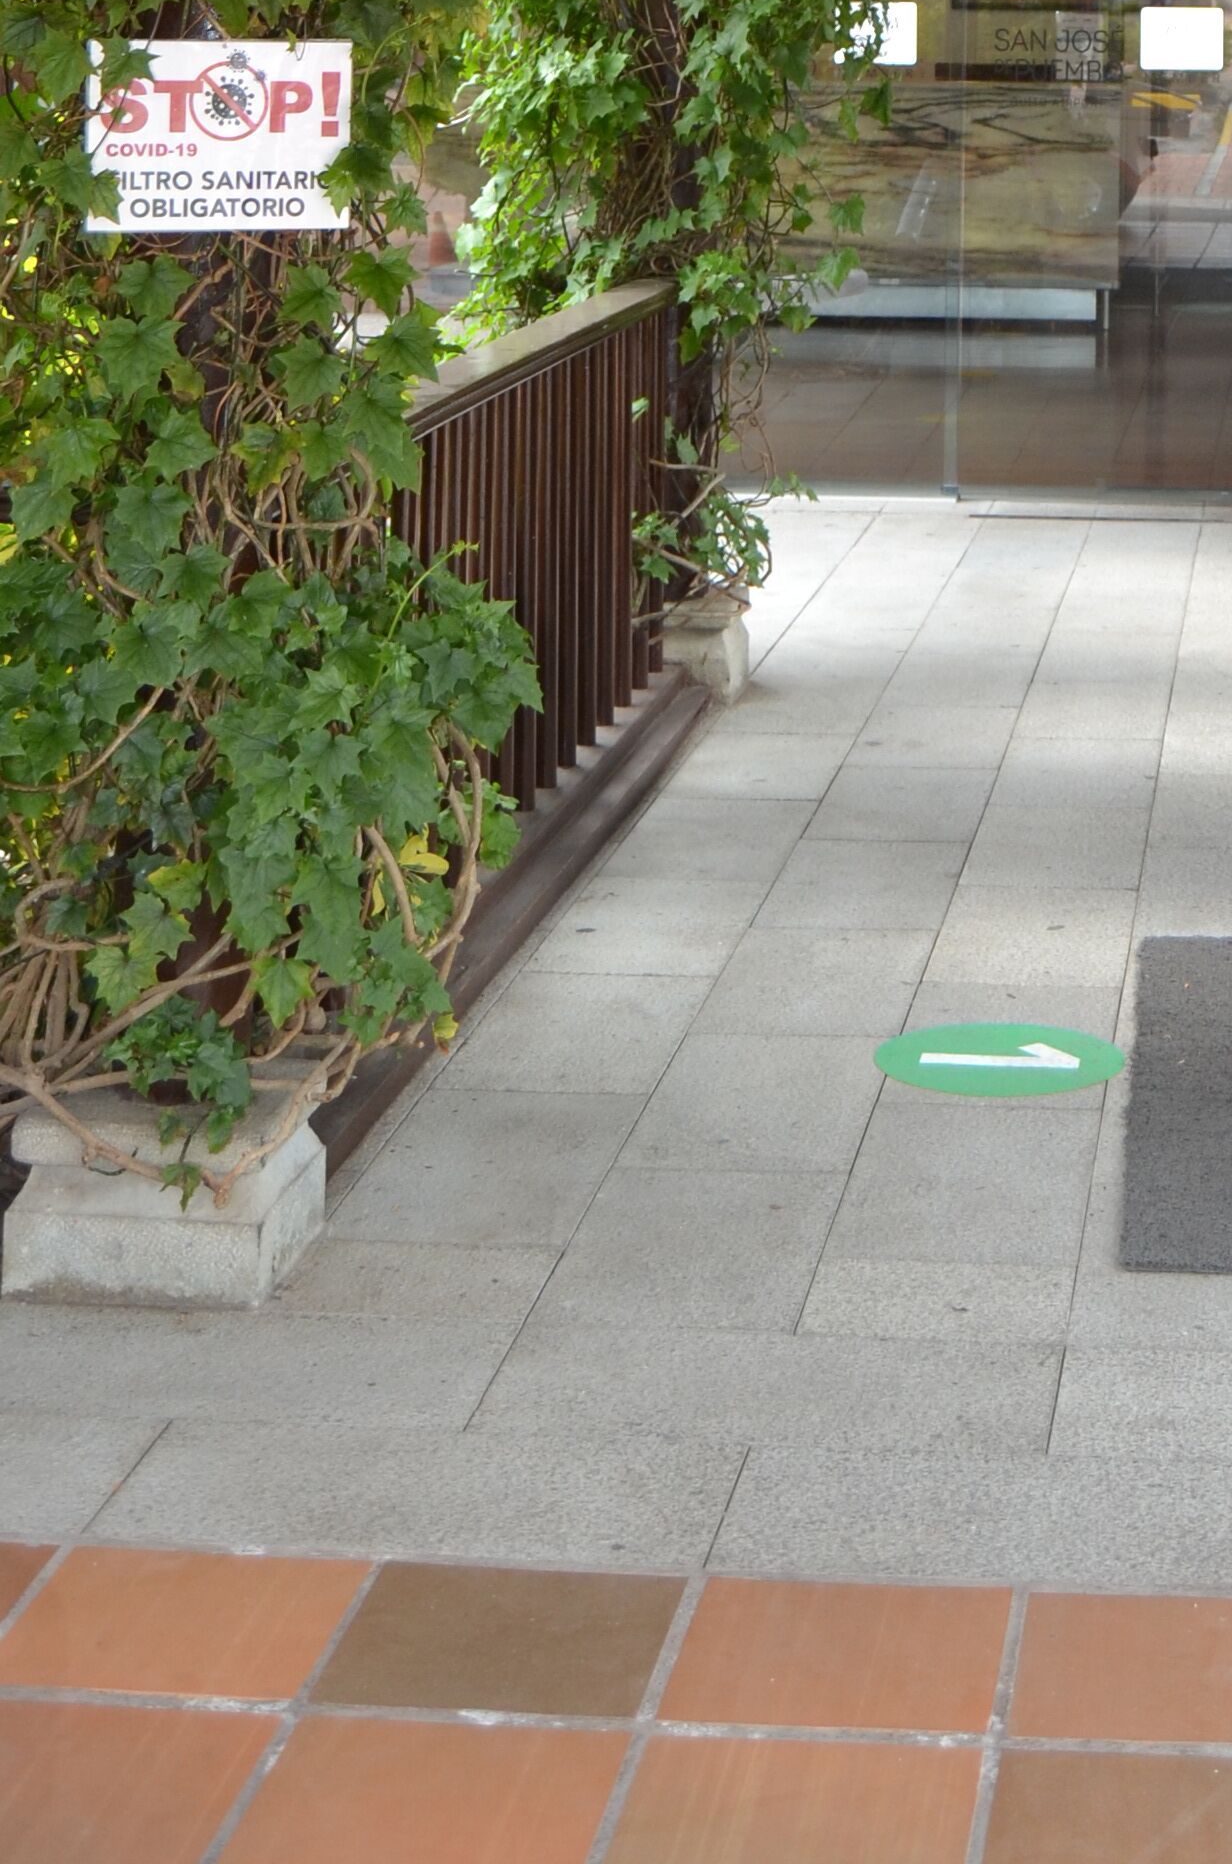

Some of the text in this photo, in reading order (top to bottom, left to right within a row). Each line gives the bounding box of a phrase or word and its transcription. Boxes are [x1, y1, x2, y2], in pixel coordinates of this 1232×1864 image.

[994, 28, 1047, 53] SAN
[105, 143, 198, 158] COVID-19
[129, 196, 305, 218] OBLIGATORIO
[918, 1040, 1081, 1072] 1
